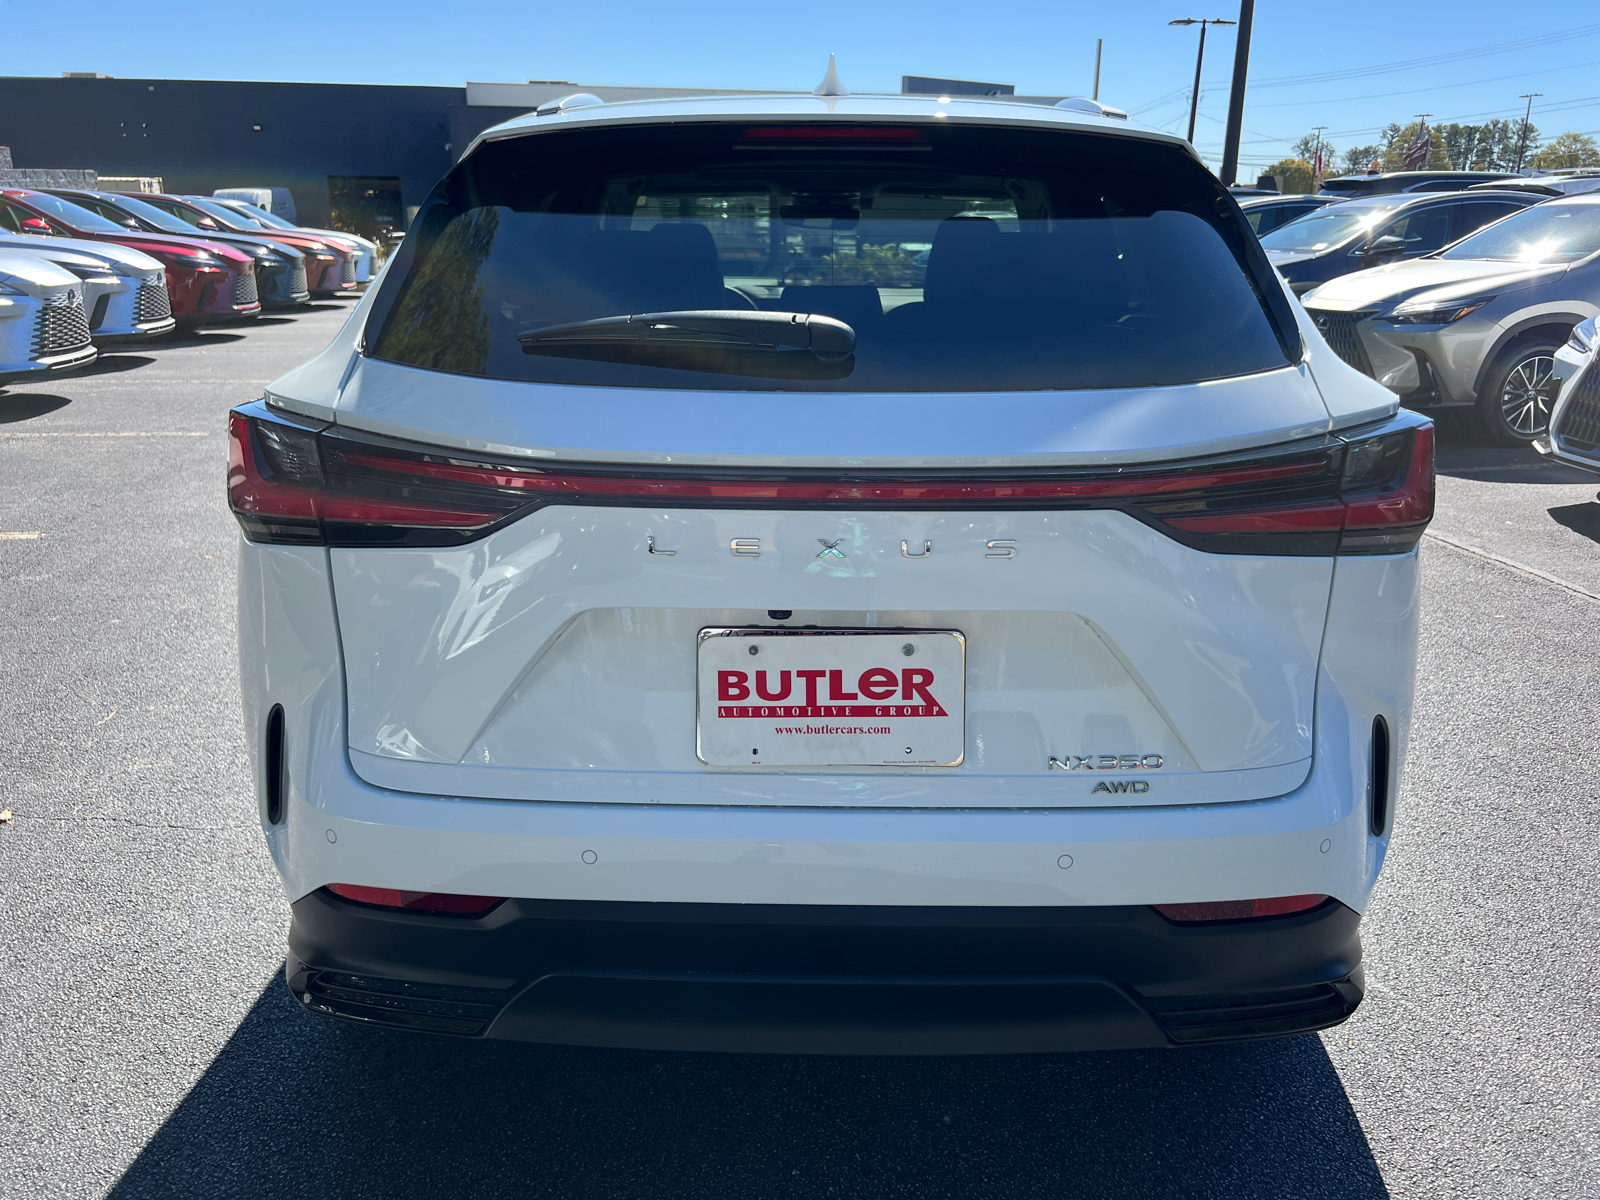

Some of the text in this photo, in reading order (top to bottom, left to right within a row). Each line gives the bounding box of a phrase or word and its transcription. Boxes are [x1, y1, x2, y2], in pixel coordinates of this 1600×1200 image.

[646, 535, 1018, 560] LEXUS
[719, 705, 940, 717] AUTOMOTIVE GROUP
[774, 724, 892, 735] www.butlercars.com
[1047, 754, 1164, 771] NX350
[1091, 779, 1150, 795] AWD
